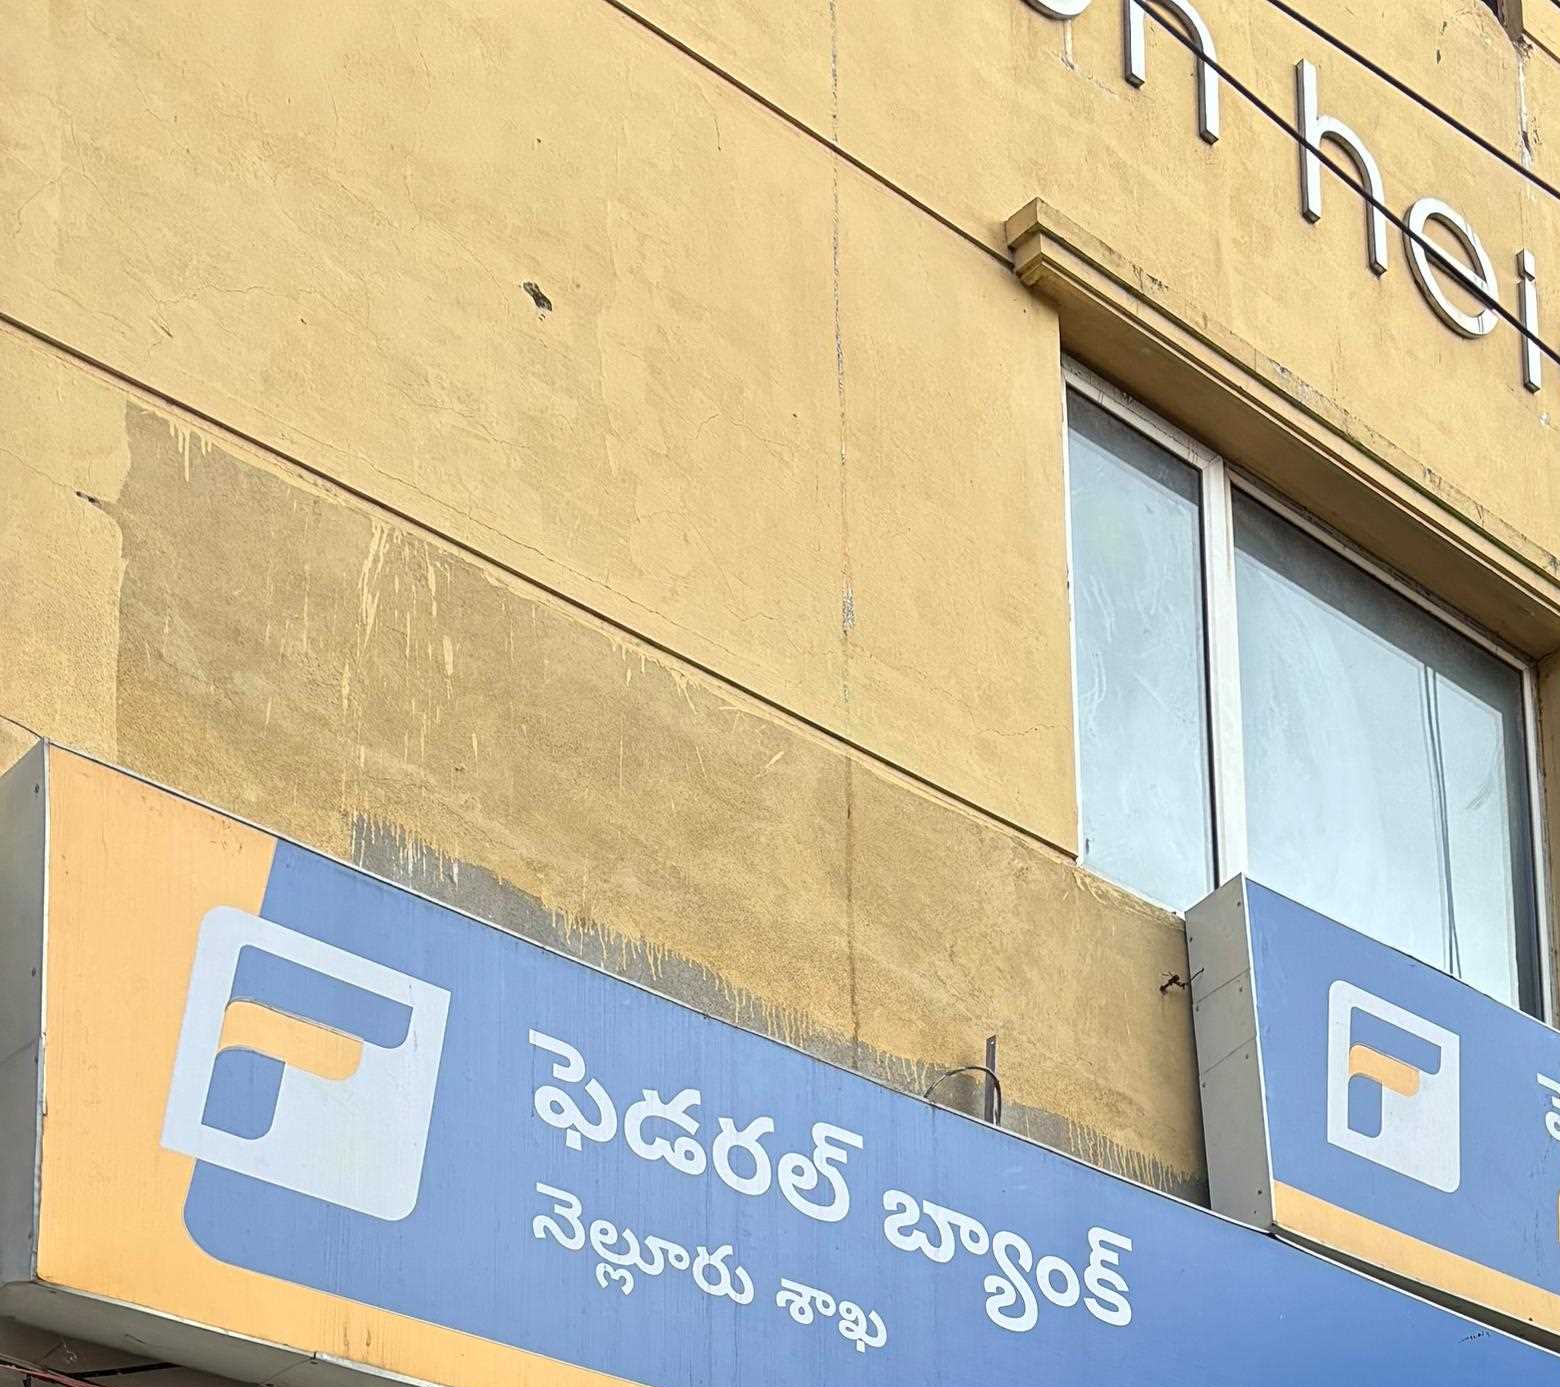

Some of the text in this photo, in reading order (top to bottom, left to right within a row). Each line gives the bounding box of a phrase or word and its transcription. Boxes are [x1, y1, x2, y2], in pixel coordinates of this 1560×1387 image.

[528, 1029, 1133, 1333] ఫెడరల్ బ్యాంక్
[532, 1182, 888, 1353] నెల్లూరు శాఖ
